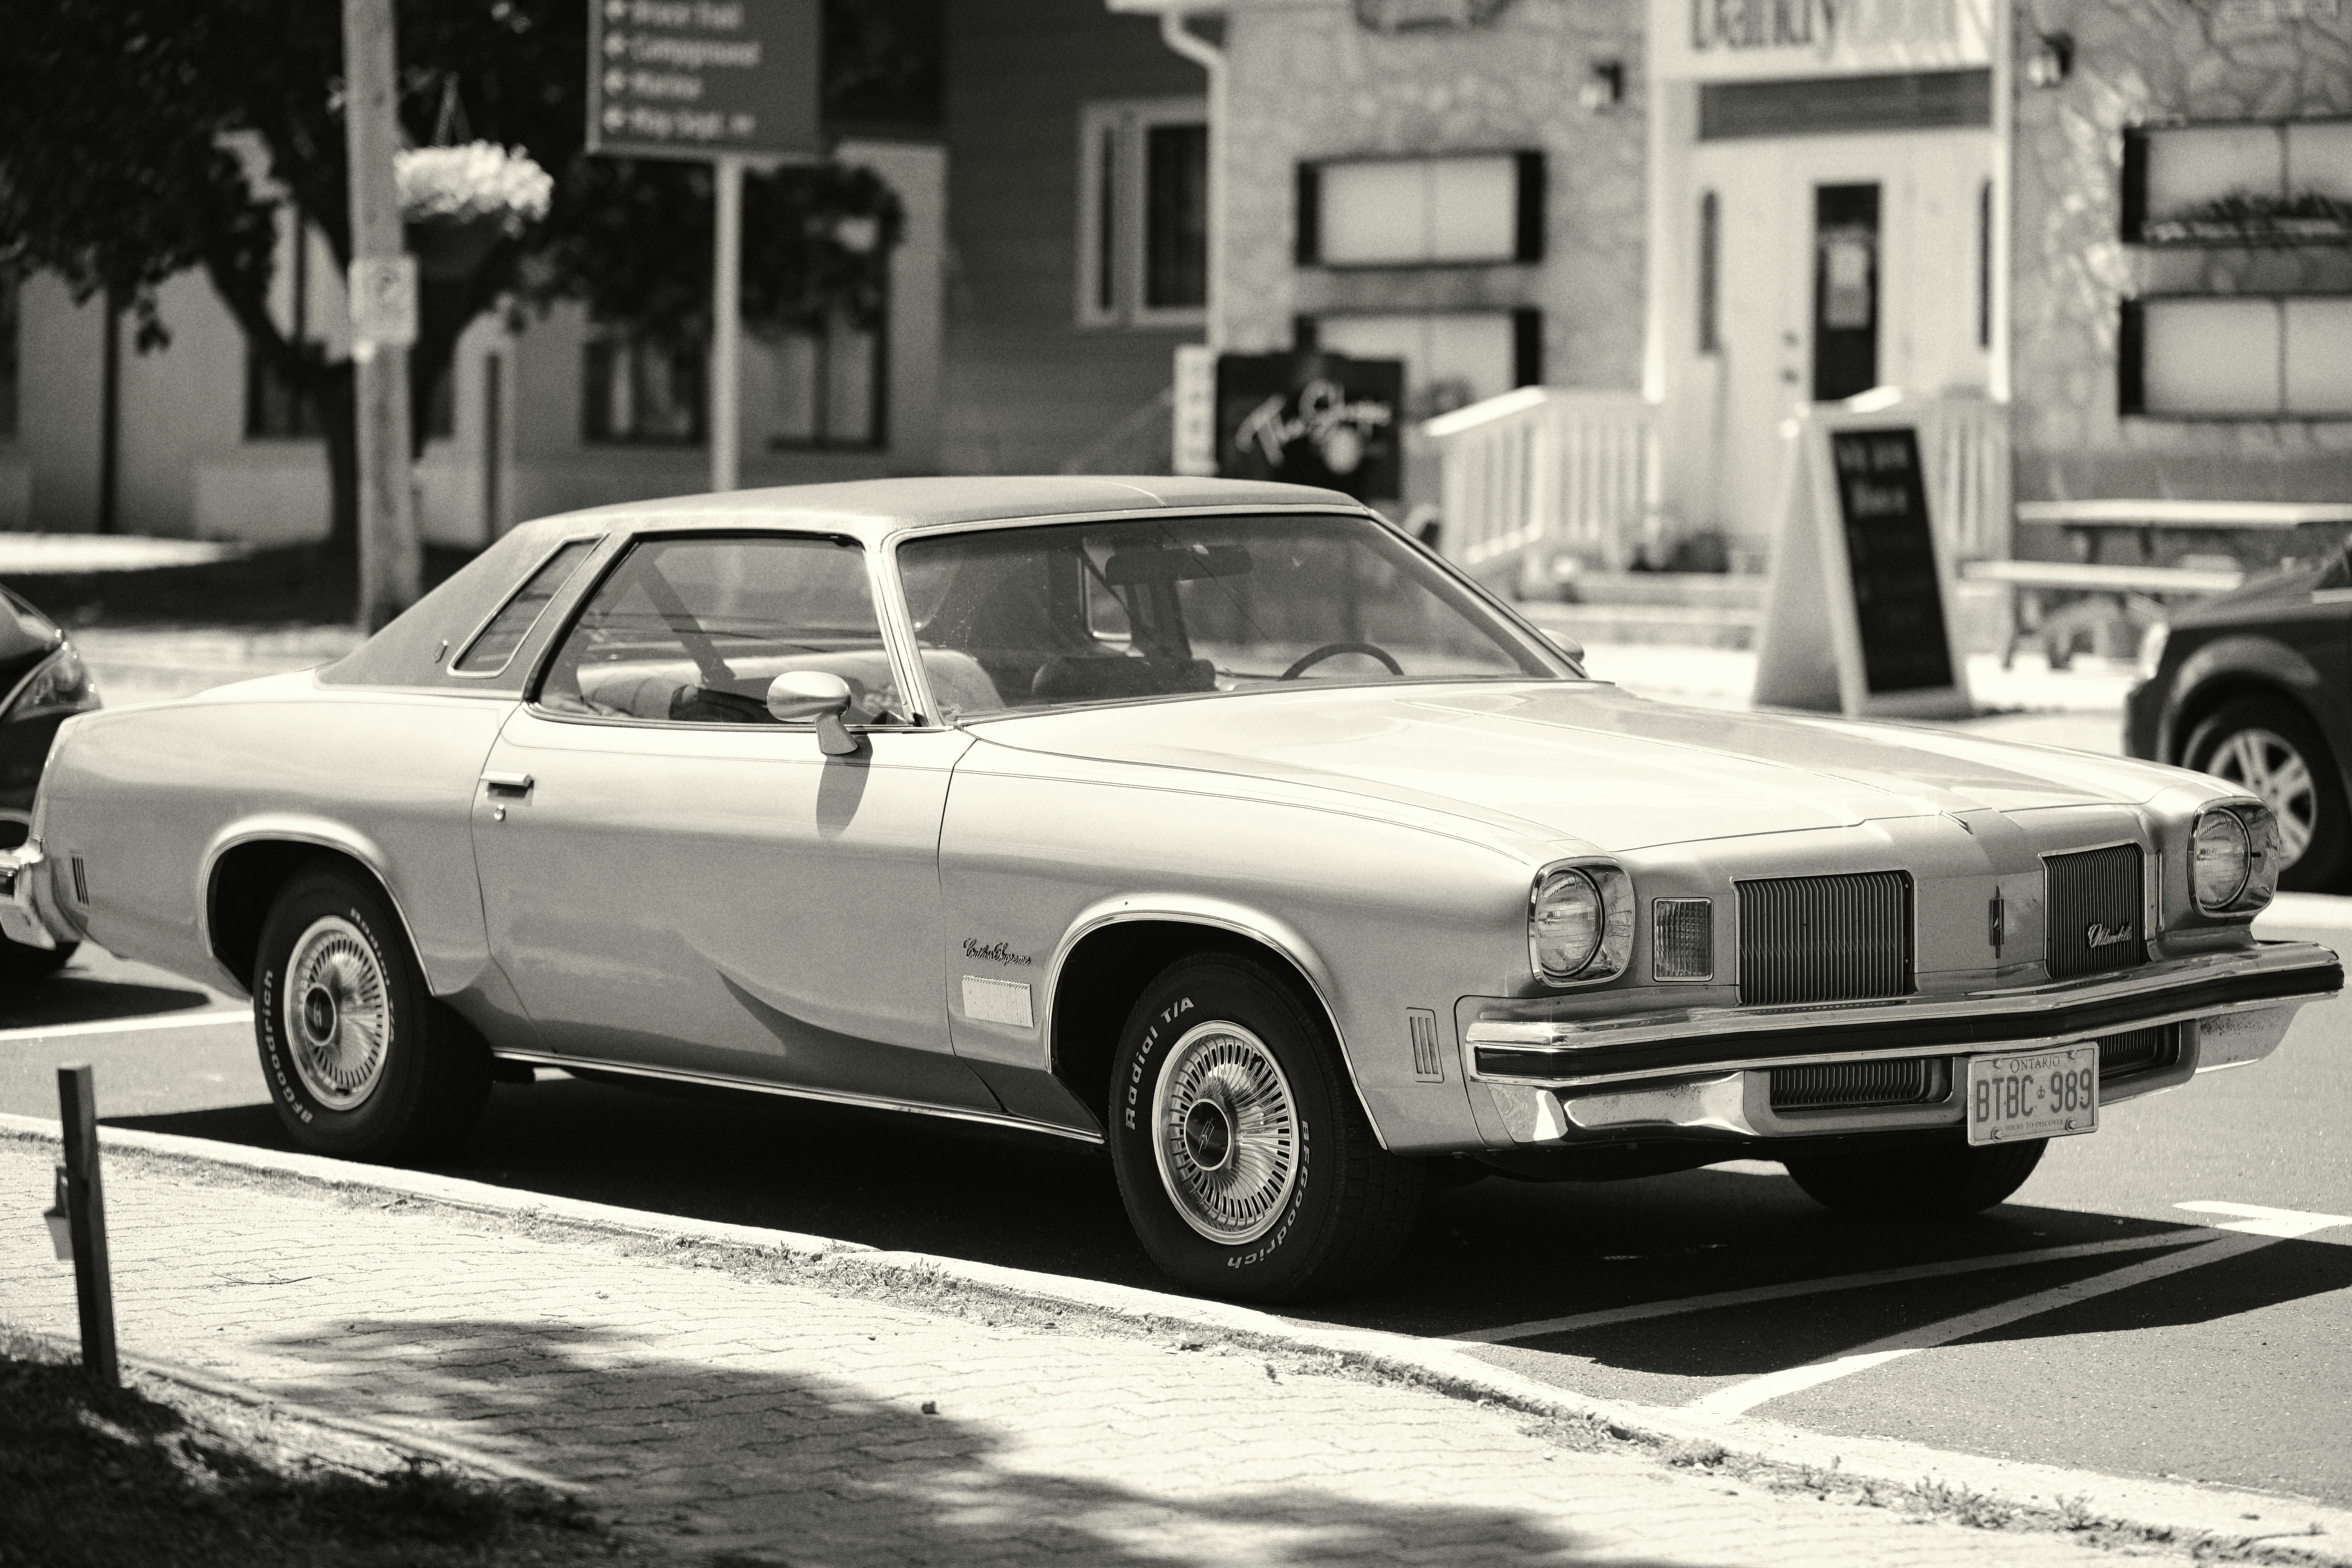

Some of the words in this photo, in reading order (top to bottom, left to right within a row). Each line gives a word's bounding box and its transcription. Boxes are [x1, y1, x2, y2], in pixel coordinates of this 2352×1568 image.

[2088, 923, 2132, 948] Oldsmobile
[1126, 1026, 1158, 1130] Radial
[1161, 997, 1194, 1023] T/A
[1976, 1075, 2034, 1122] BTBC
[2050, 1068, 2093, 1113] 989
[2035, 1119, 2063, 1127] DISCOVER
